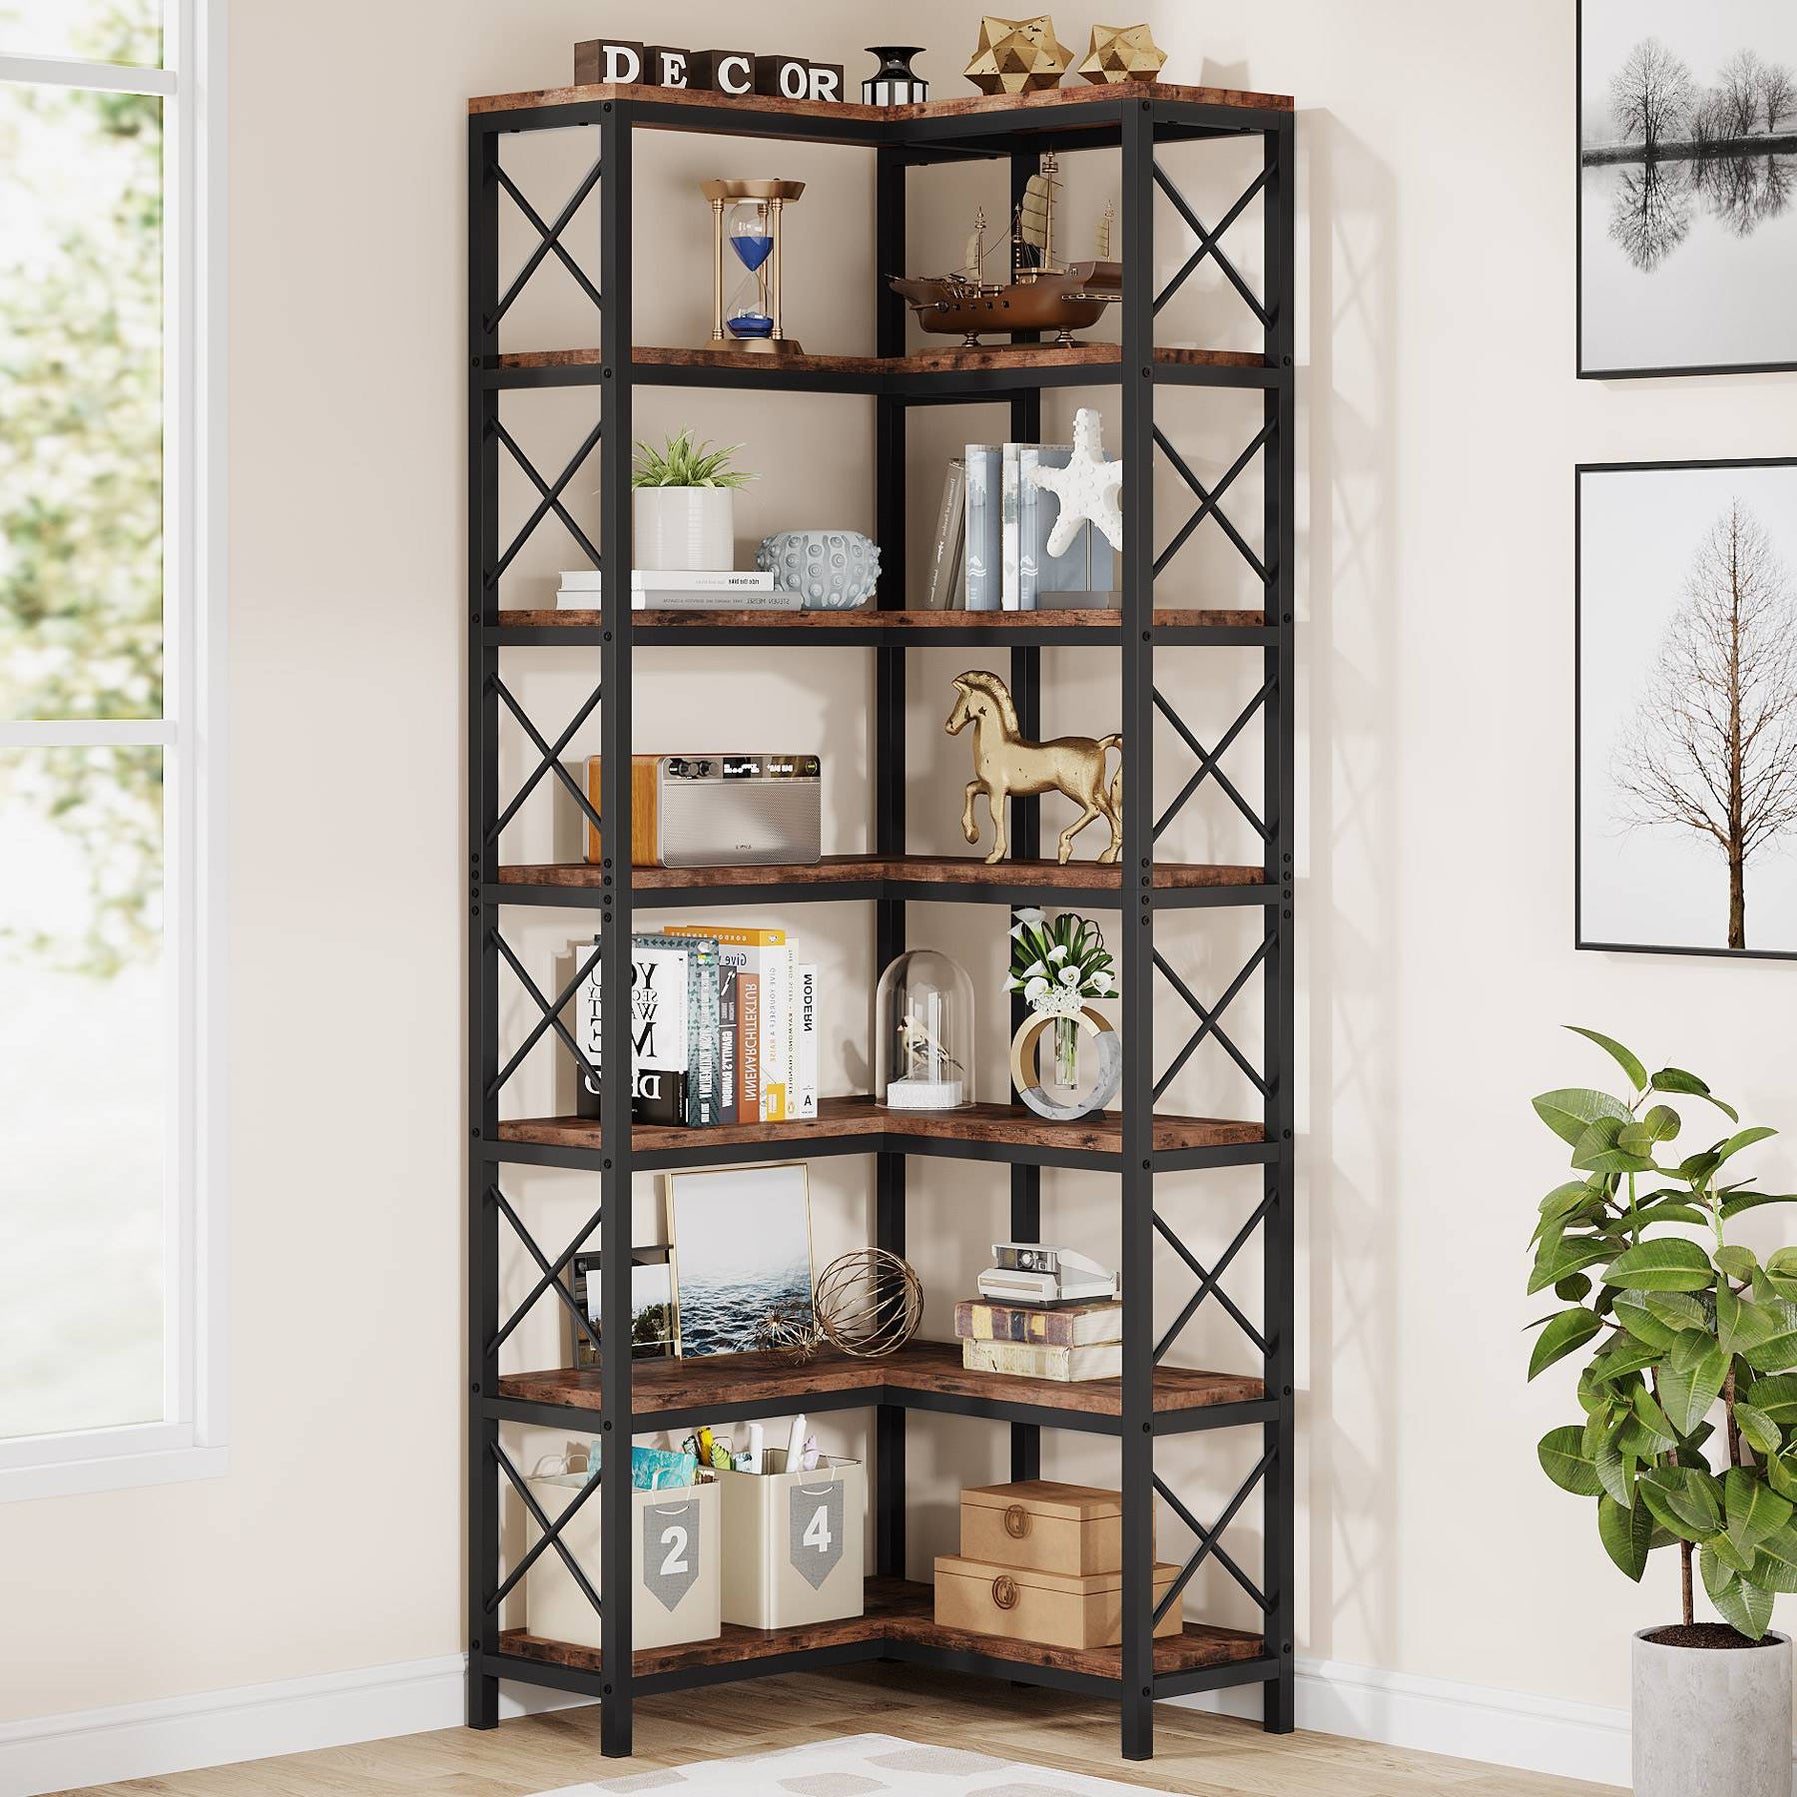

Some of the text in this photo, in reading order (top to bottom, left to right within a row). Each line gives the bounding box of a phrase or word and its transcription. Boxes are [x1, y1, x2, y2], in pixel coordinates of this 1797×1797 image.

[602, 45, 841, 103] DECOR
[803, 1094, 812, 1106] A
[659, 1525, 689, 1576] 2
[802, 1504, 832, 1553] 4
